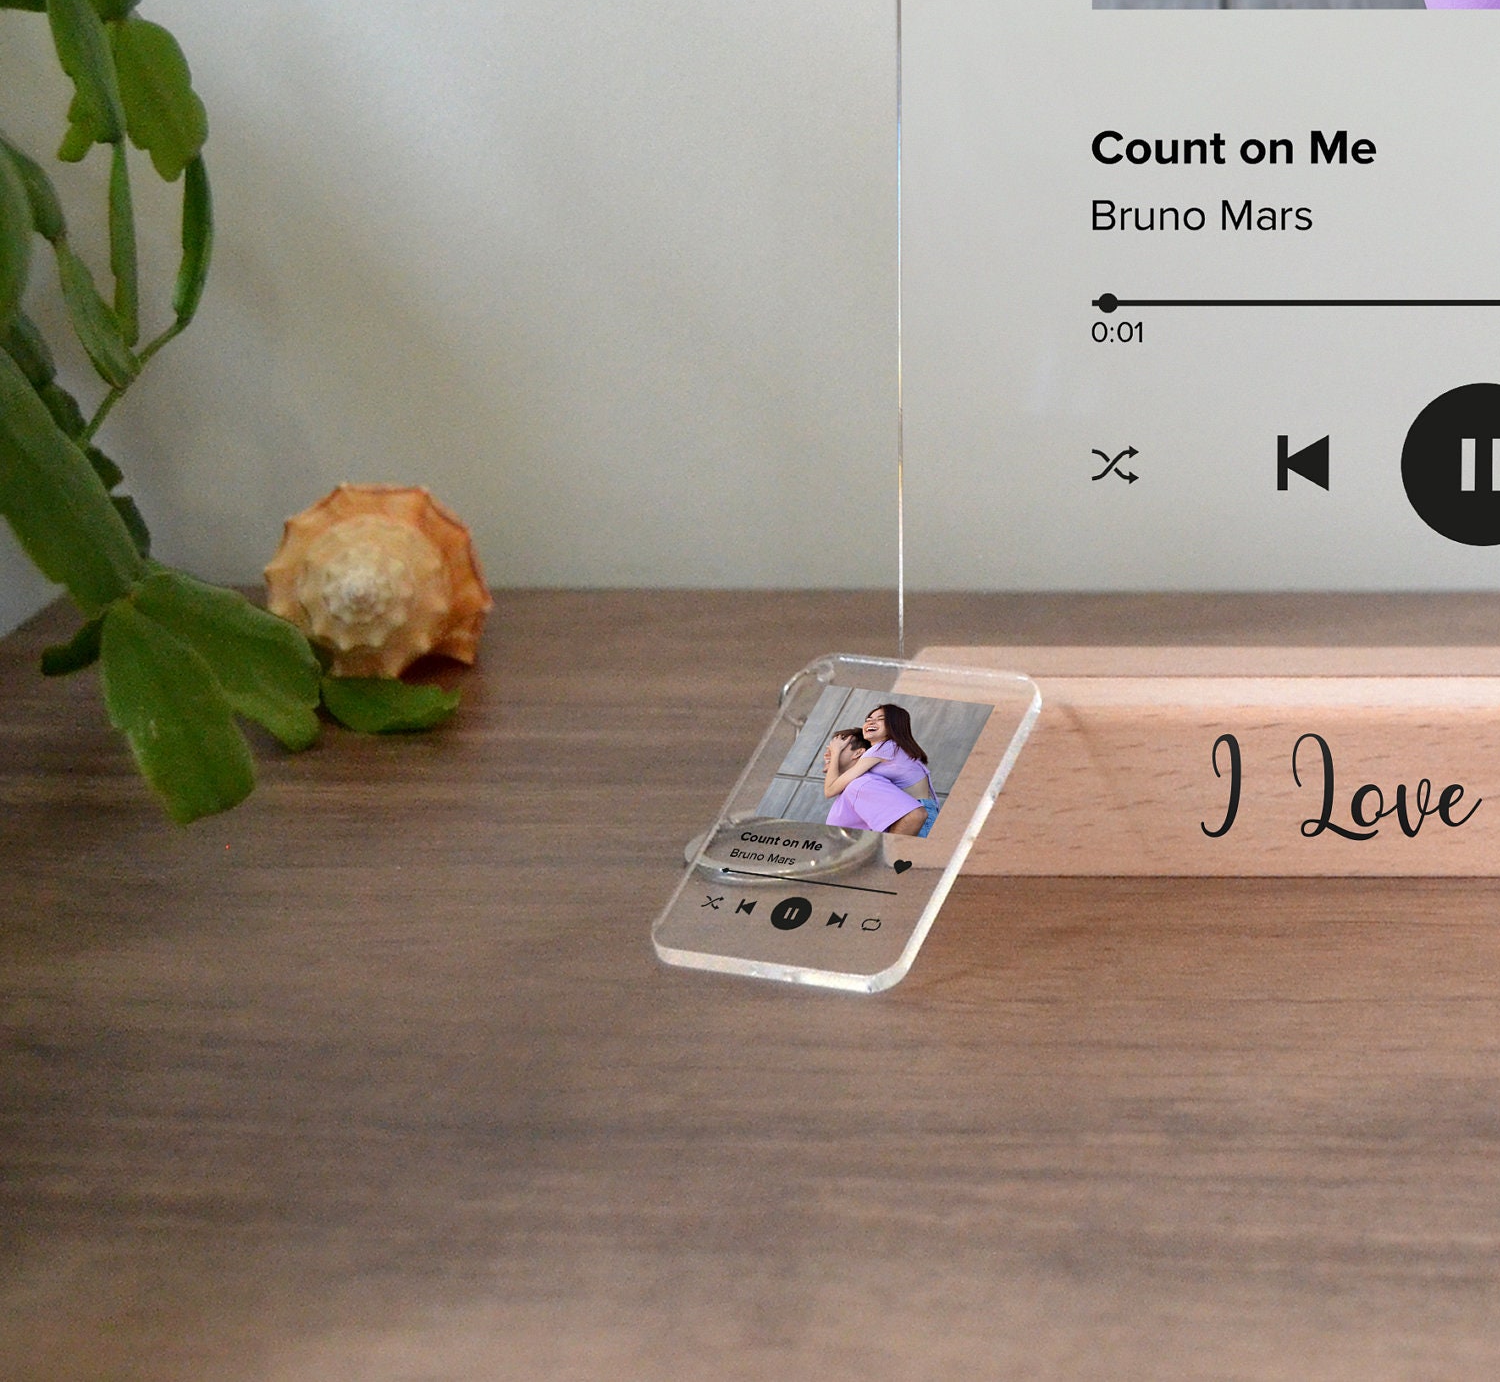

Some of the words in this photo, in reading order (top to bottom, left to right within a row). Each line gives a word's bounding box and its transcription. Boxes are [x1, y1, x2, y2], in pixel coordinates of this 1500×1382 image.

[1091, 130, 1226, 165] Count
[1239, 138, 1294, 165] on
[1310, 130, 1377, 165] Me
[1092, 199, 1206, 231] Bruno
[1221, 199, 1313, 231] Mars
[1091, 321, 1143, 343] 0:01
[1200, 733, 1242, 838] I
[1292, 733, 1483, 841] Love
[740, 831, 780, 846] Count
[782, 838, 799, 849] on
[801, 839, 823, 851] Me
[729, 848, 764, 861] Bruno
[767, 853, 796, 865] Mars
